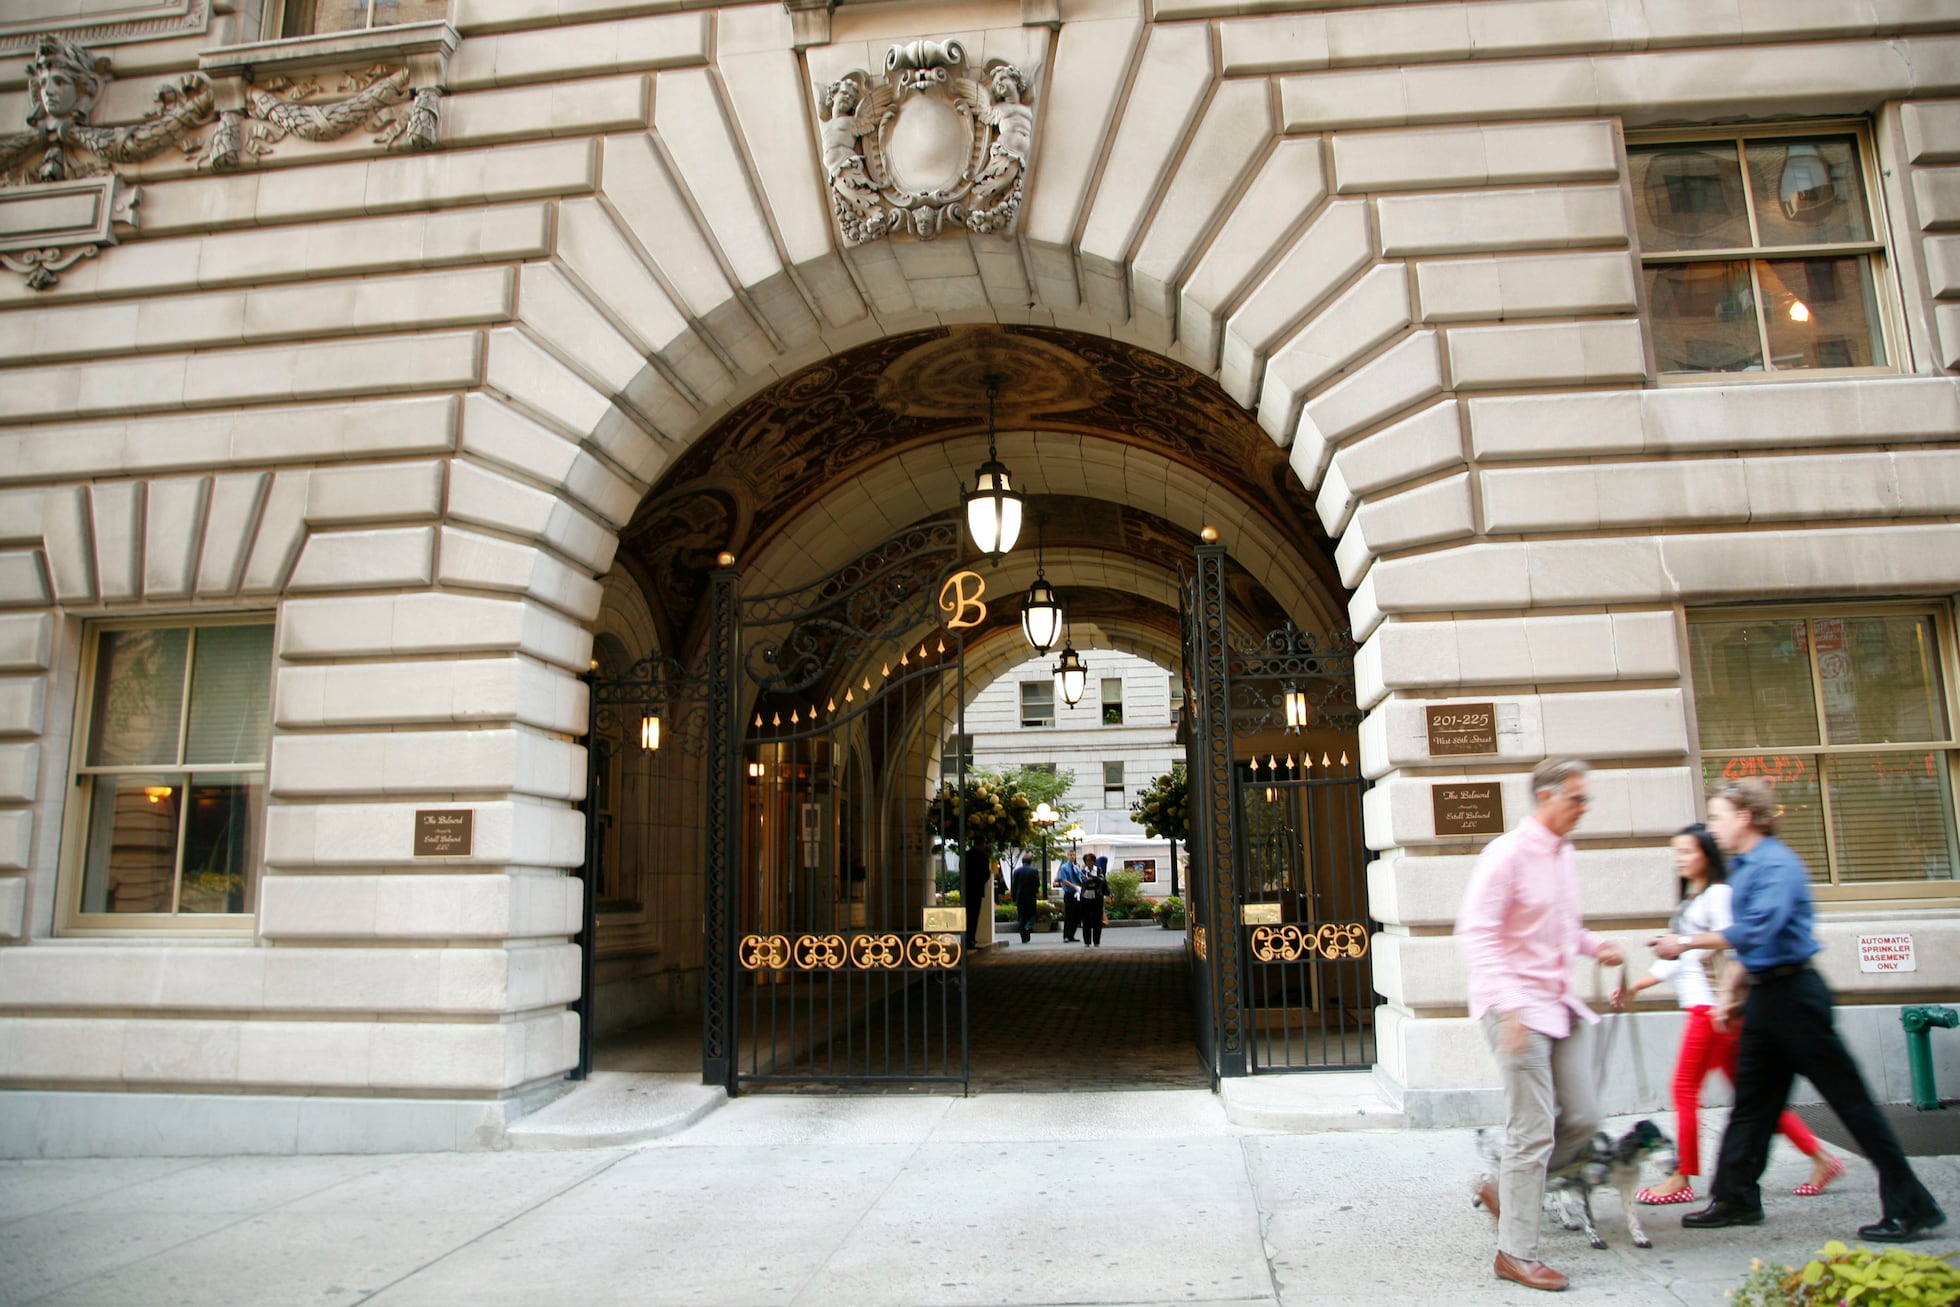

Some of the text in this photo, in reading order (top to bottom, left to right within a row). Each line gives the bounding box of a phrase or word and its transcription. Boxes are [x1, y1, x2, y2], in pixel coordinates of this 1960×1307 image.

[939, 571, 986, 629] B
[1433, 714, 1489, 727] 201-225
[1433, 734, 1492, 745] West 86th Street
[1442, 790, 1458, 800] The
[1861, 937, 1909, 945] AUTOMATIC
[1861, 945, 1910, 953] SPRINKLER
[1863, 954, 1910, 962] BASEMENT
